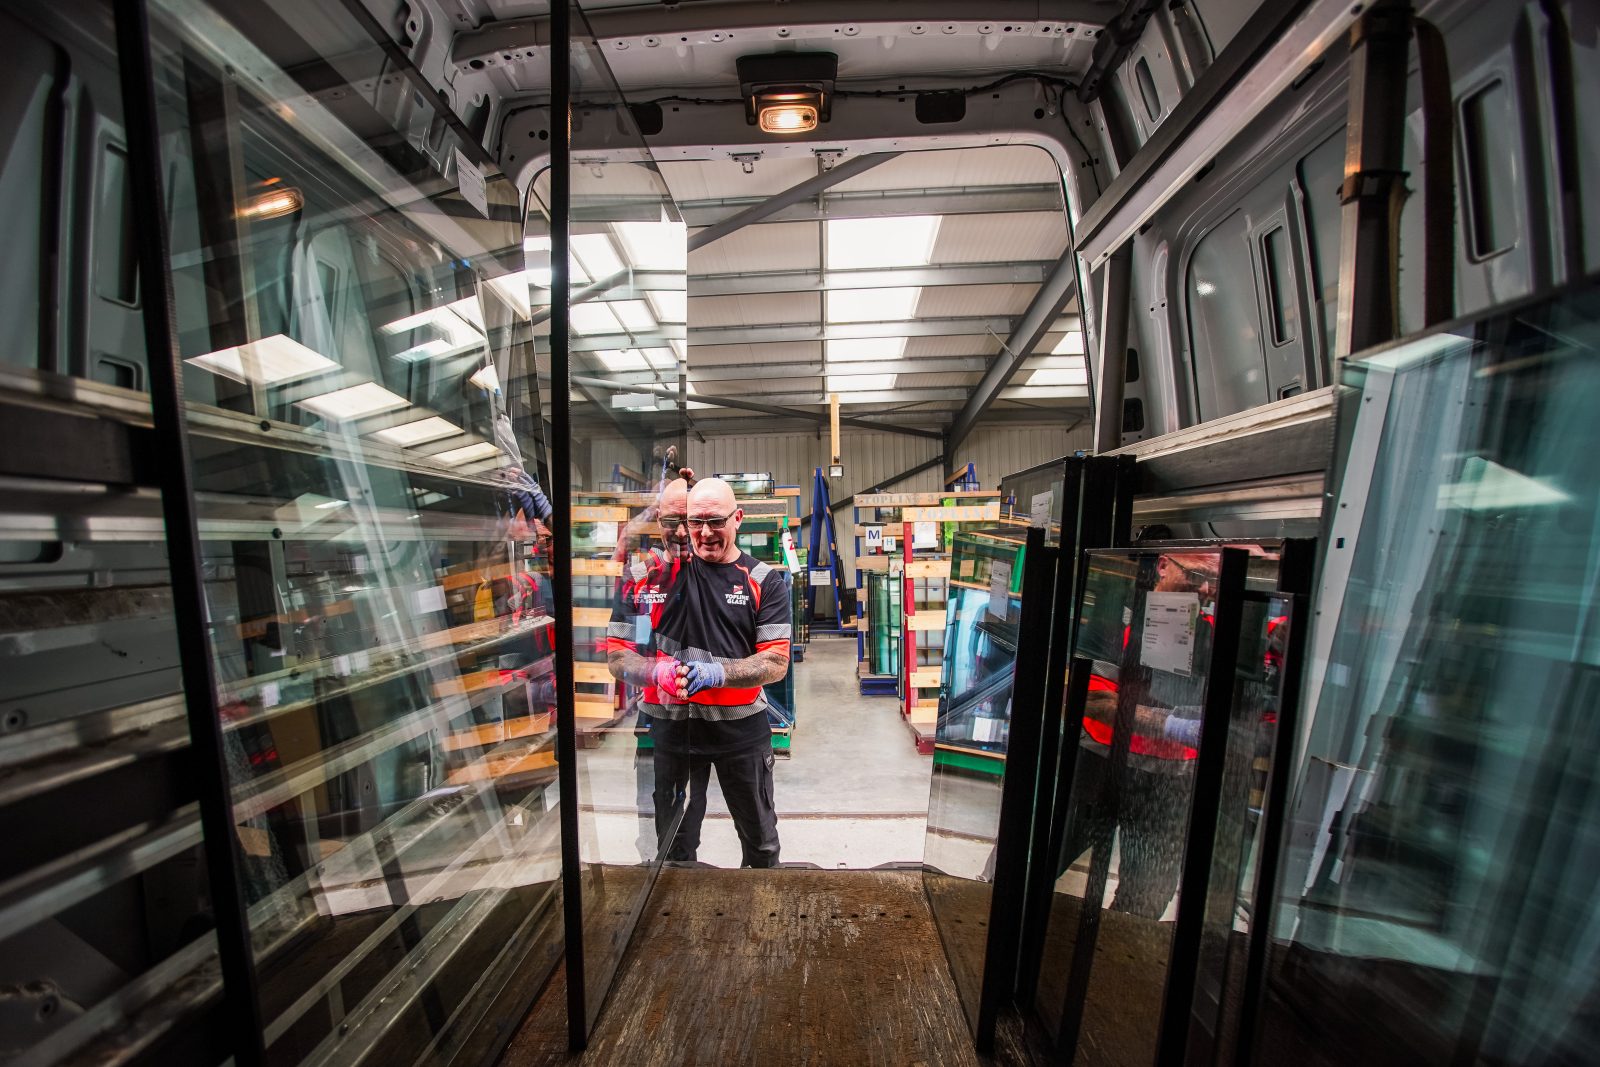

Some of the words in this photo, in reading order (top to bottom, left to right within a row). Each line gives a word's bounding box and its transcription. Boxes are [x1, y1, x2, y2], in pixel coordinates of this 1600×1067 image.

[864, 495, 921, 504] TOPLINE
[916, 507, 993, 519] TOPLINE
[868, 530, 880, 540] M
[724, 593, 749, 601] TOPLINE
